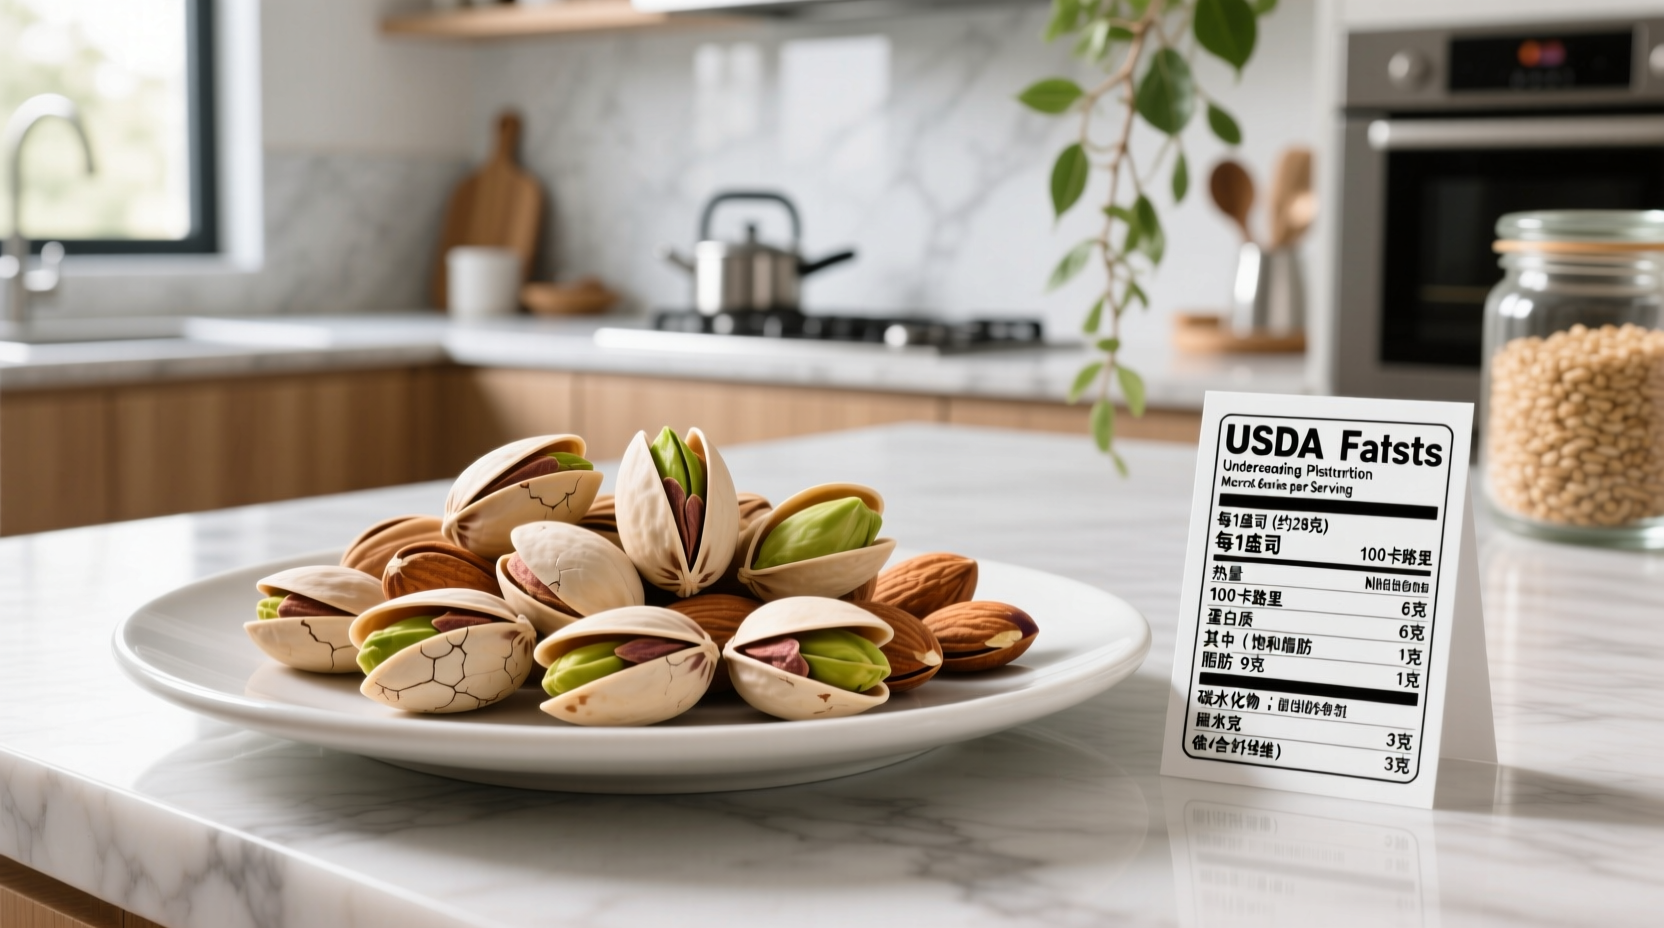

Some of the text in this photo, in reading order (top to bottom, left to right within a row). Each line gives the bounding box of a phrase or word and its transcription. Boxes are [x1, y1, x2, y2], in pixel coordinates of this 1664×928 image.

[1226, 423, 1323, 460] USDA
[1290, 481, 1308, 493] per
[1310, 480, 1353, 498] Serving
[1402, 601, 1427, 618] 6克
[1399, 624, 1424, 641] 6克
[1399, 648, 1422, 666] 1克
[1397, 672, 1420, 689] 1克
[1386, 733, 1413, 751] 3克
[1384, 757, 1410, 774] 3克
